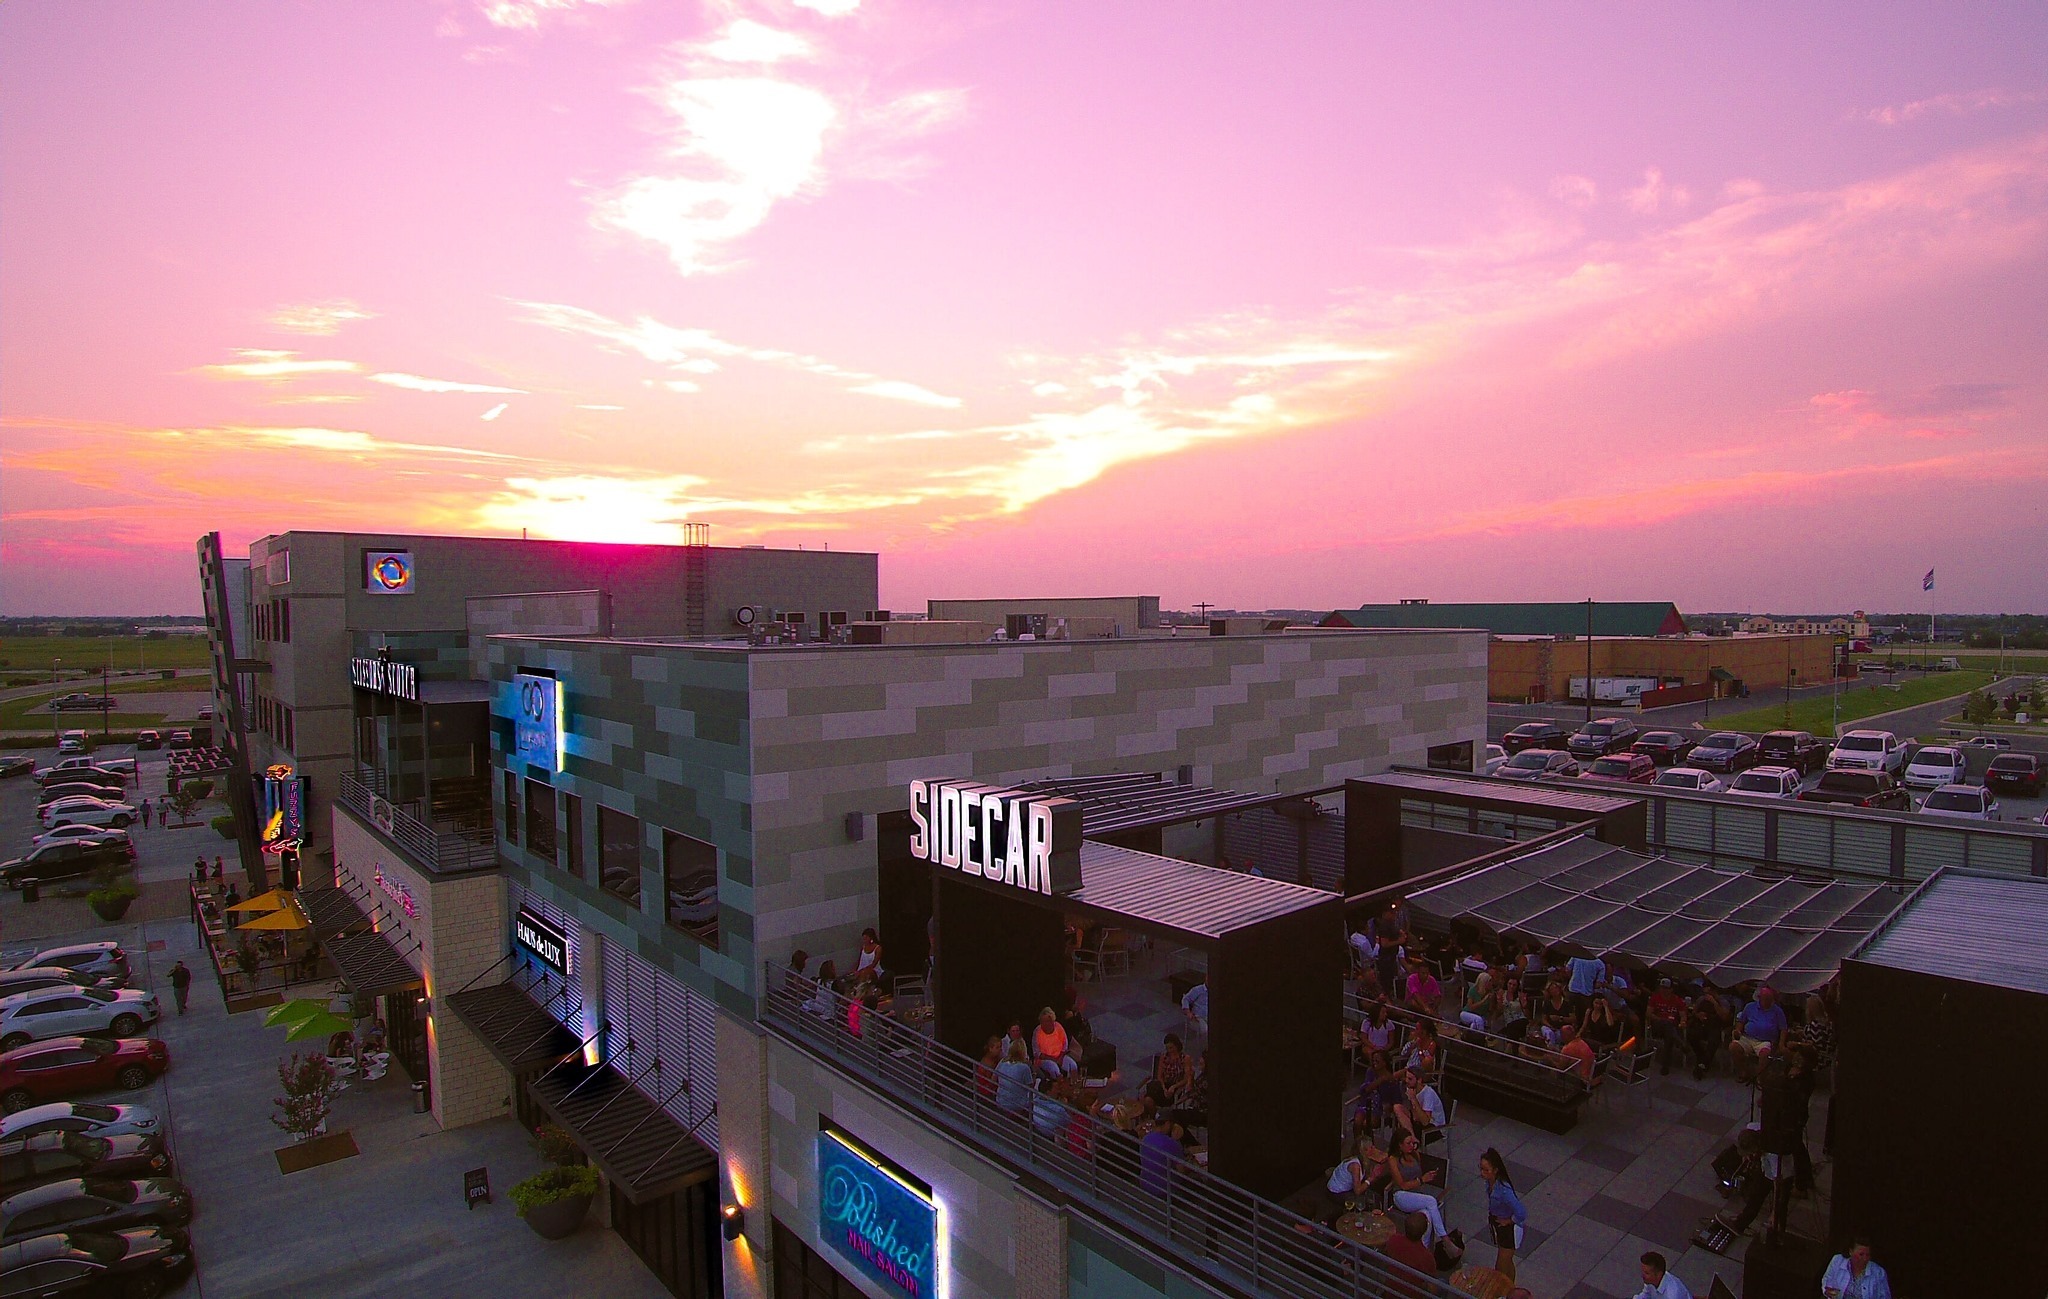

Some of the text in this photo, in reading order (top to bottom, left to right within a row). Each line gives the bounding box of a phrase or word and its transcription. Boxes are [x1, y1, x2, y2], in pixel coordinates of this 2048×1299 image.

[387, 662, 416, 701] SCOTCH
[910, 780, 1053, 895] SIDECAR
[517, 920, 536, 949] HAUS
[544, 939, 561, 967] LUX
[823, 1164, 930, 1277] Polished
[847, 1228, 919, 1298] NAIL SALON
